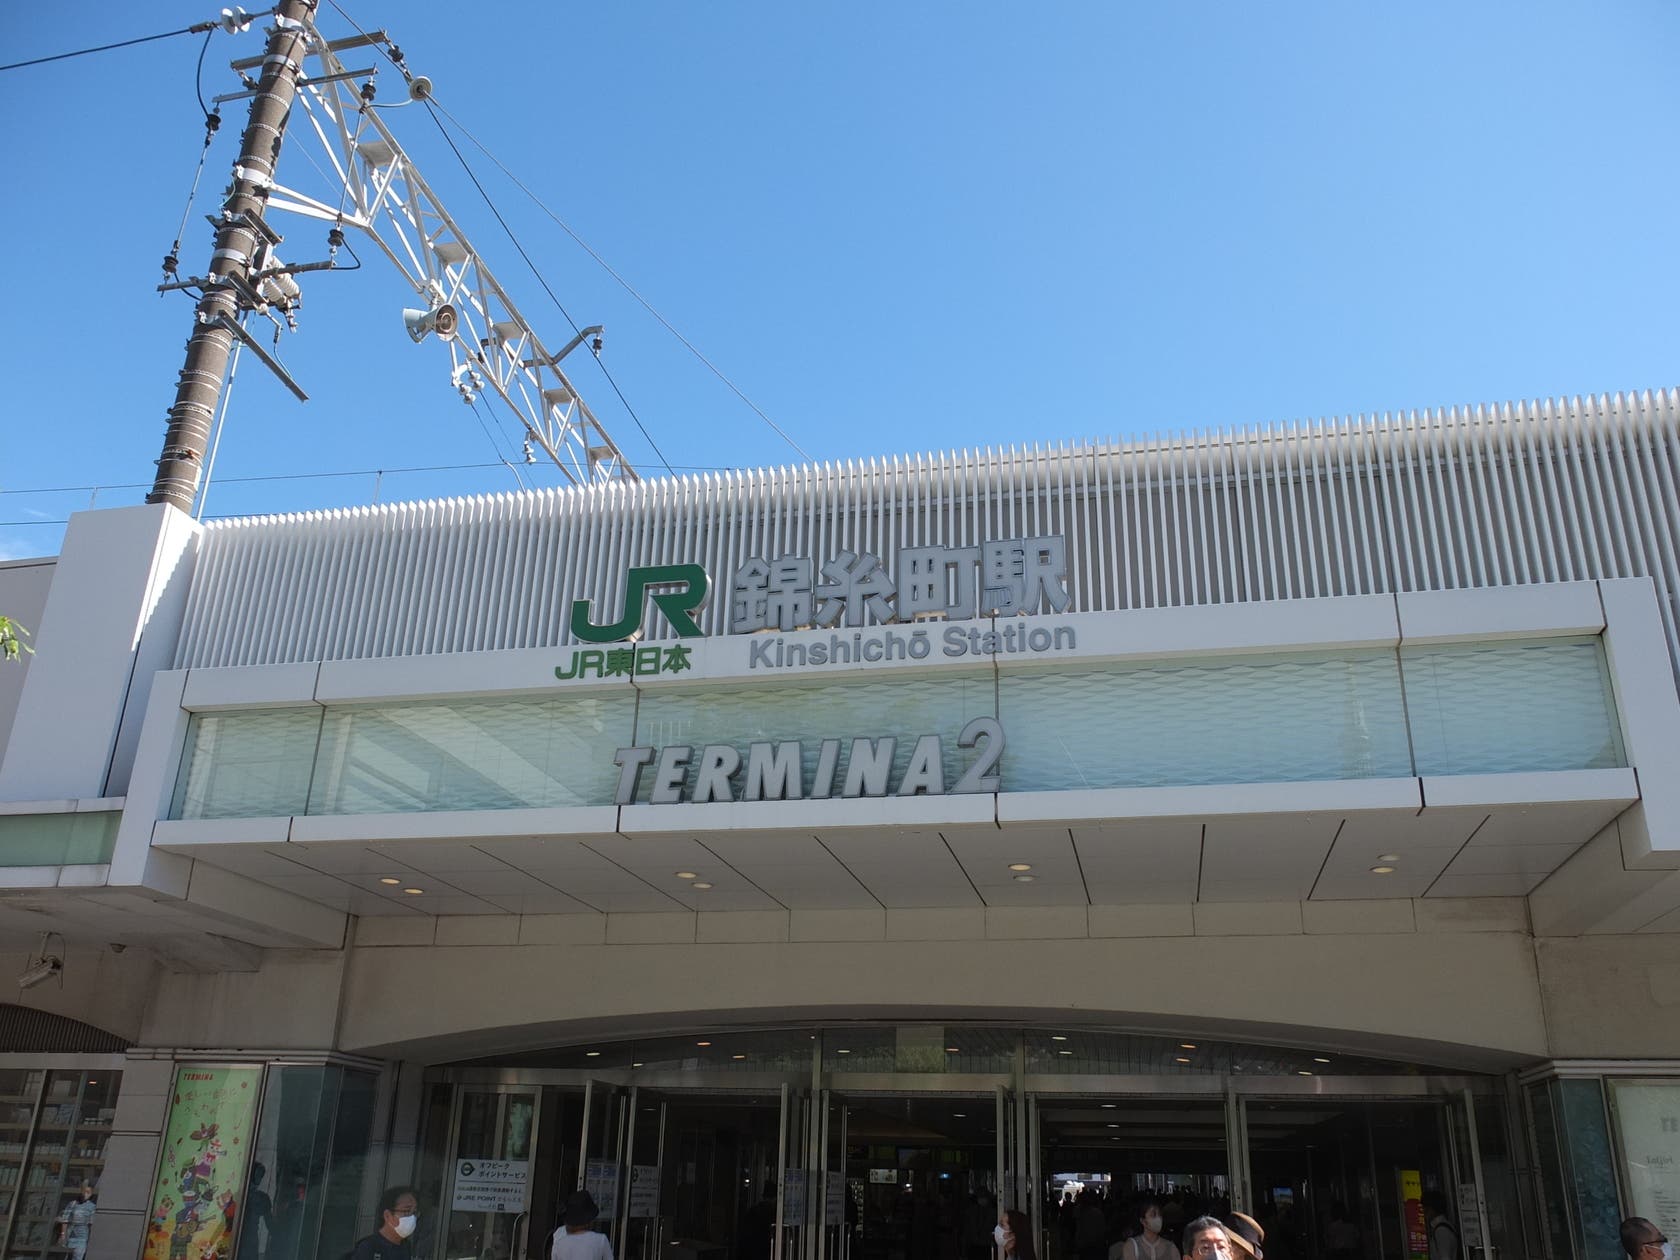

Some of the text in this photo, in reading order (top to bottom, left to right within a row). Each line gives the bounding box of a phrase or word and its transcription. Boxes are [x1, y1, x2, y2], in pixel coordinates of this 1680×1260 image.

[570, 563, 712, 644] JR
[732, 535, 1072, 635] 錦糸町駅
[554, 643, 692, 680] JR東日本
[750, 622, 1077, 669] Kinshichō Station
